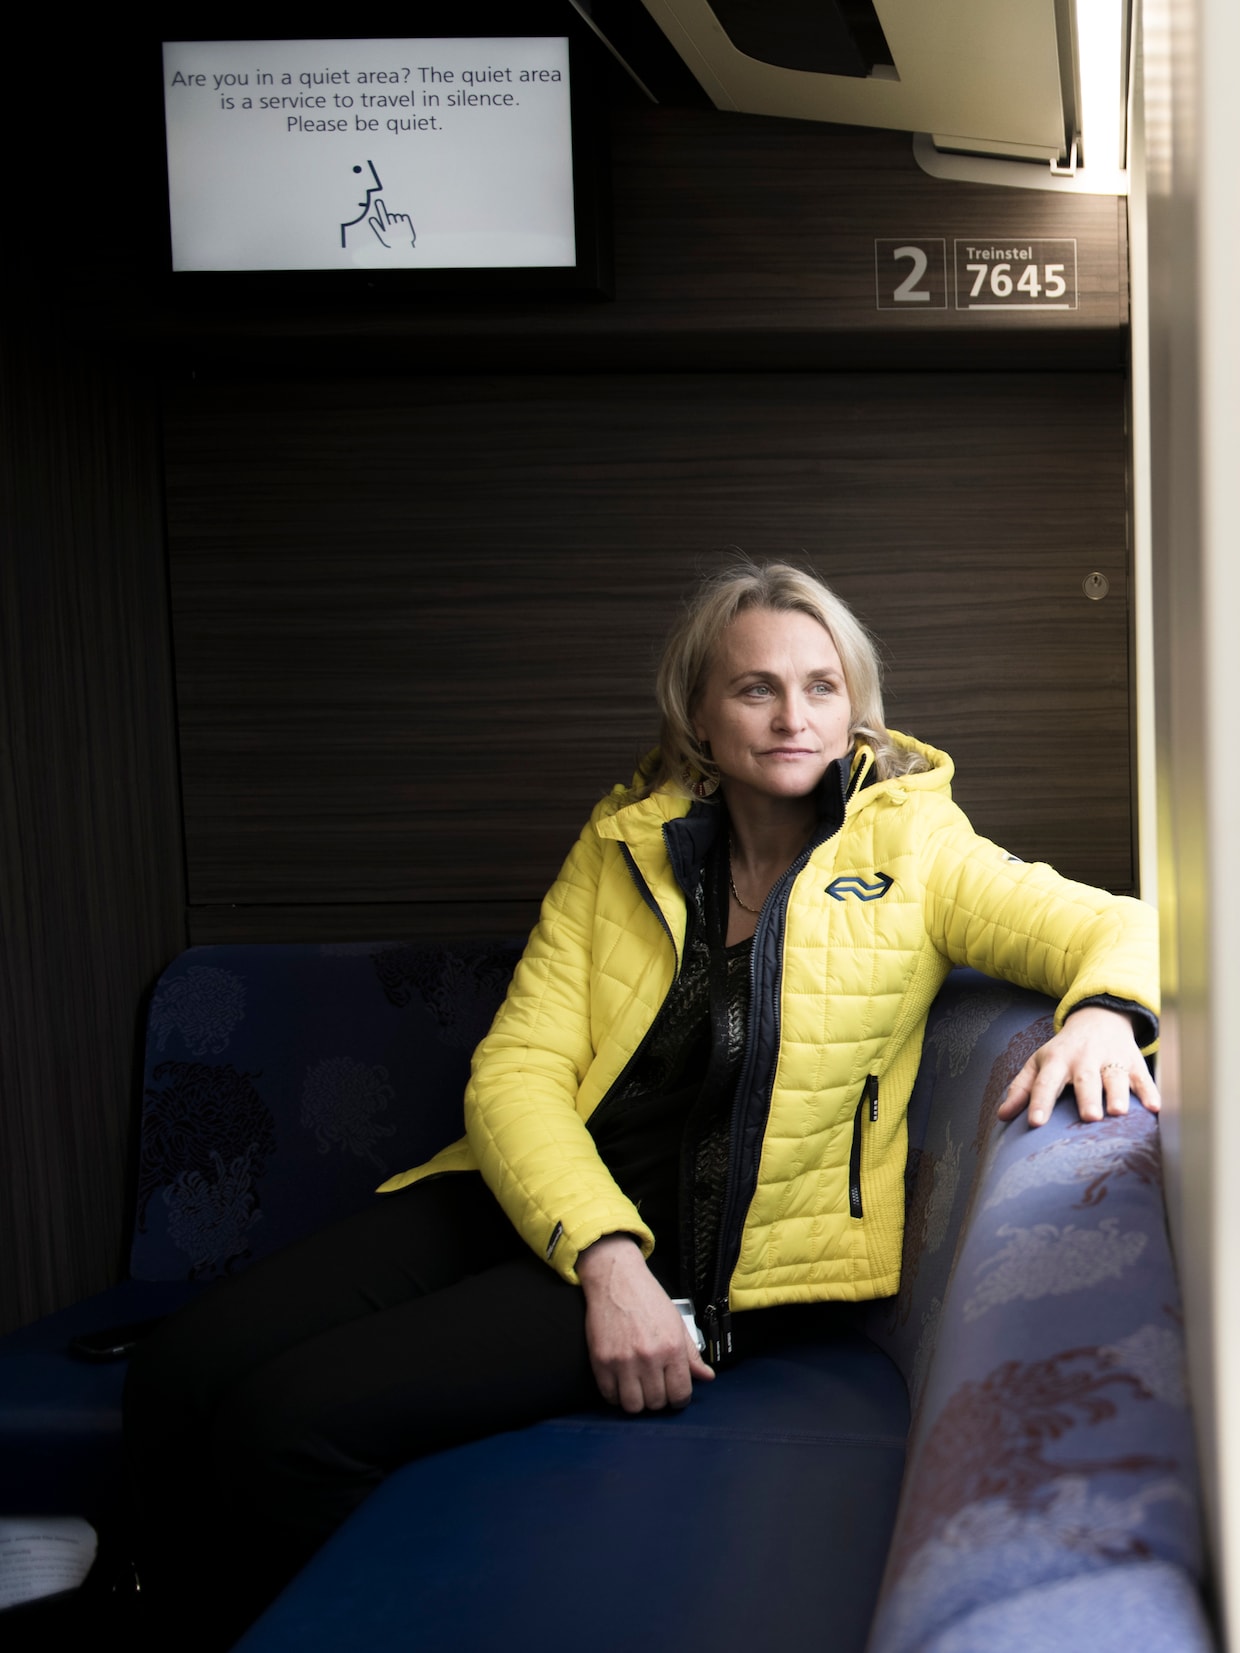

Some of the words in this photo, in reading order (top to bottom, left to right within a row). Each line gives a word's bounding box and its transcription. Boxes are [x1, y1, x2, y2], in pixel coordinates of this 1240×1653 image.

[171, 70, 207, 88] Are
[212, 73, 249, 91] you
[256, 68, 274, 86] in
[280, 72, 292, 86] a
[298, 67, 351, 90] quiet
[356, 67, 411, 85] area?
[416, 65, 455, 84] The
[461, 65, 513, 88] quiet
[519, 69, 563, 83] area
[220, 92, 236, 110] is
[241, 96, 253, 110] a
[258, 91, 327, 110] service
[332, 92, 355, 109] to
[359, 89, 415, 108] travel
[422, 89, 440, 107] in
[446, 89, 520, 107] silence.
[286, 114, 349, 133] Please
[354, 113, 380, 132] be
[385, 113, 443, 136] quiet.
[965, 246, 1033, 261] Treinstel
[892, 245, 931, 302] 2
[965, 263, 1067, 298] 7645
